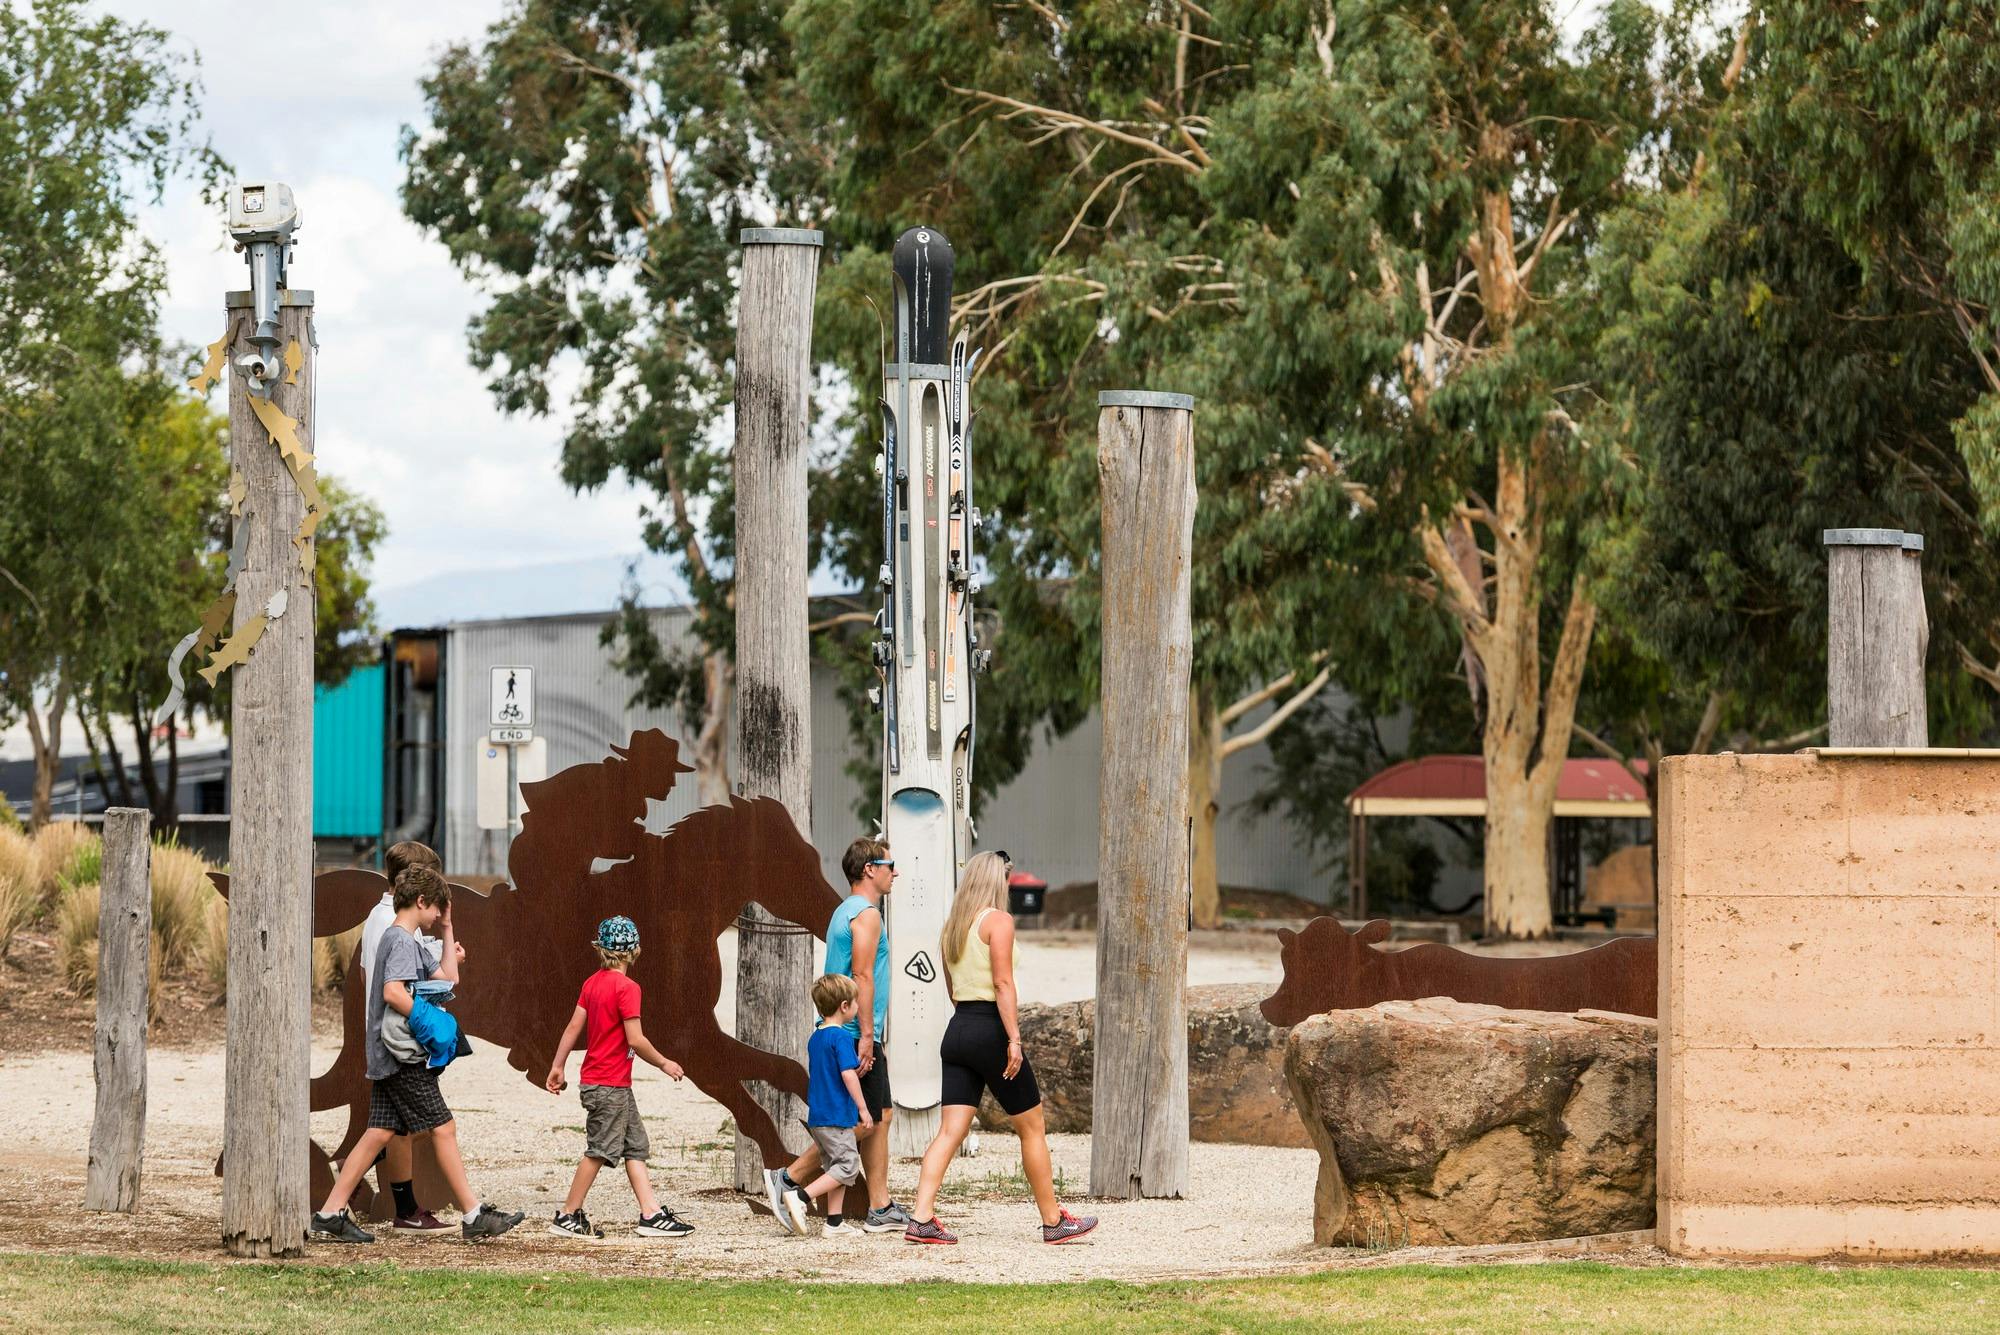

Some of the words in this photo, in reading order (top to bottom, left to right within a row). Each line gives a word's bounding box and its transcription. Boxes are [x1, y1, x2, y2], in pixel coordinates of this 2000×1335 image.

[926, 426, 934, 477] ROSSIGNOL
[886, 429, 895, 527] DYNASTAR
[929, 680, 937, 731] ROSSIGNOL
[500, 731, 523, 740] END
